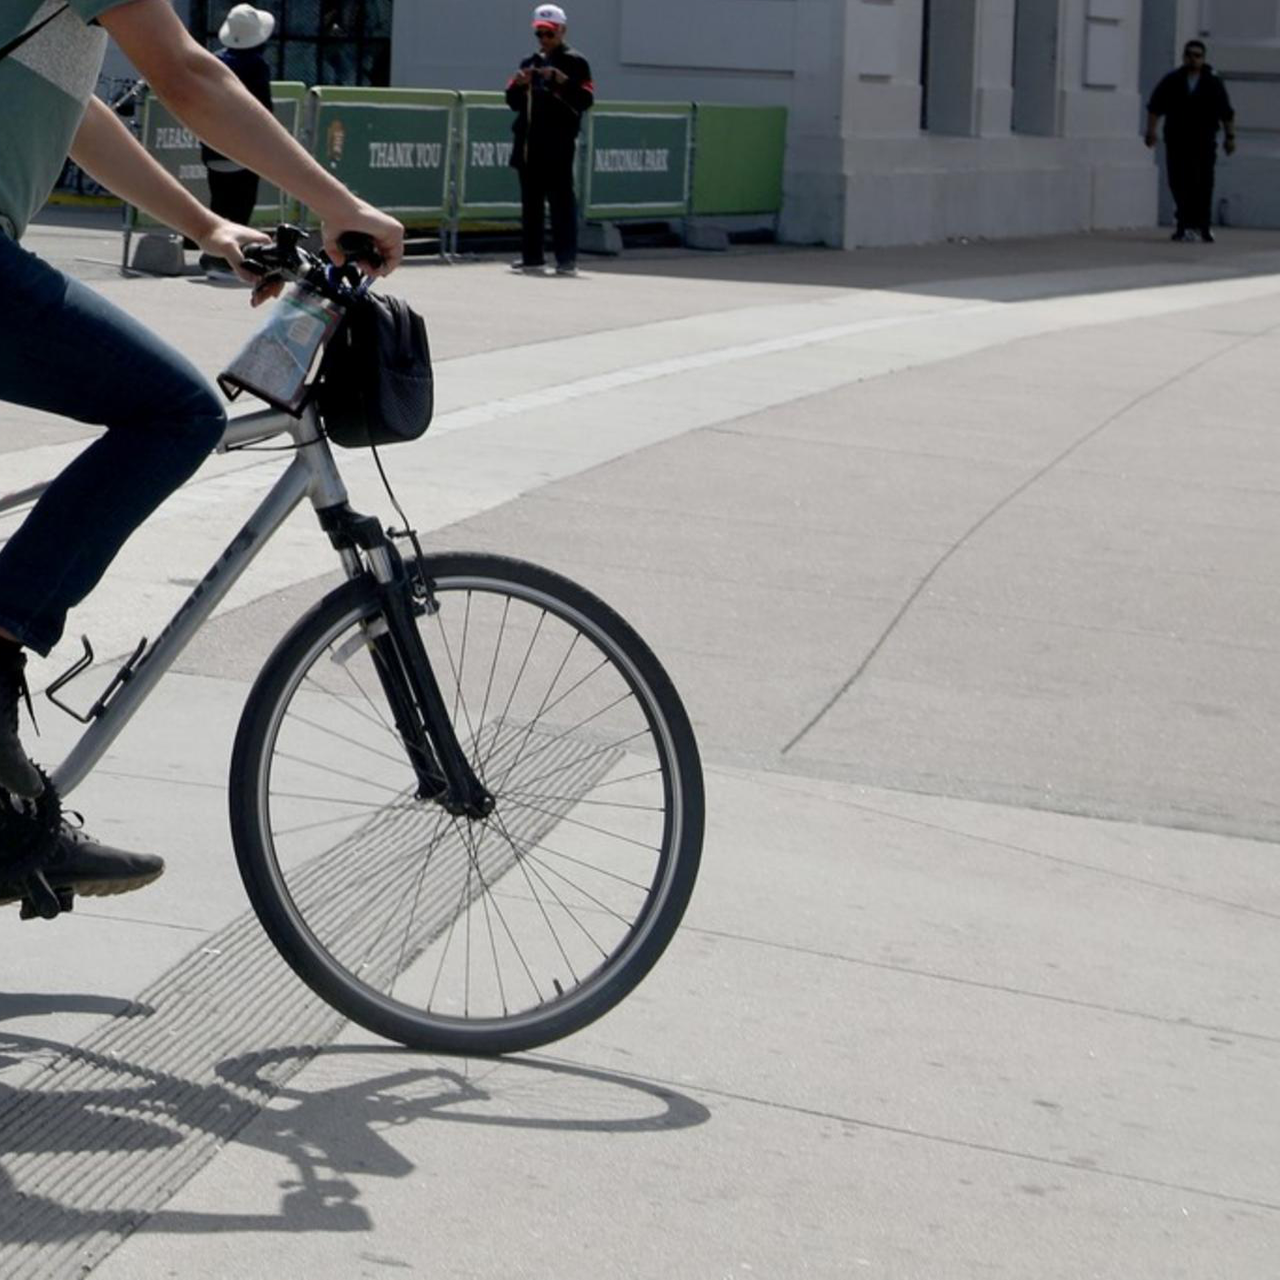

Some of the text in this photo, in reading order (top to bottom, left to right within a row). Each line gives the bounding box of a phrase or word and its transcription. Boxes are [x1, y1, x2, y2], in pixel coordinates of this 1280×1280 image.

[369, 142, 442, 168] THANK YOU
[471, 141, 495, 167] FOR
[593, 148, 669, 172] NATIONAL PARK
